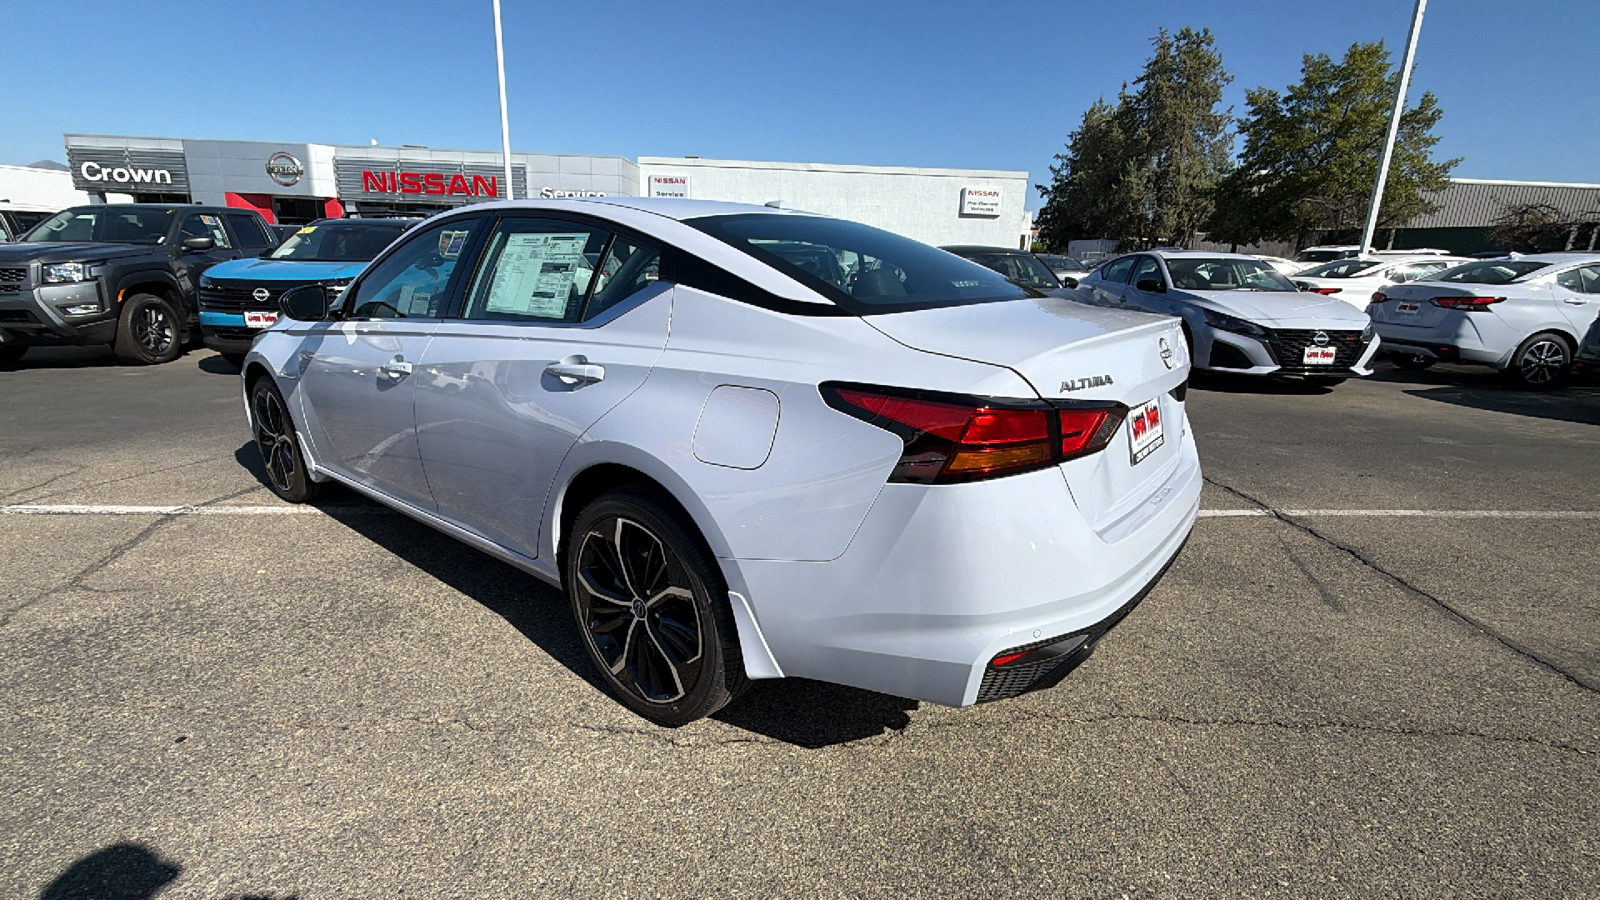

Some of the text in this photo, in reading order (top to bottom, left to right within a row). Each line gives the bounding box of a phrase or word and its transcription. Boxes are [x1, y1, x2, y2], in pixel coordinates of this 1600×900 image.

[80, 161, 173, 184] Crown
[362, 170, 499, 198] NISSAN
[653, 177, 686, 185] NISSAN
[540, 187, 608, 198] Service
[655, 190, 684, 198] Service
[1059, 374, 1114, 394] ALTIMA
